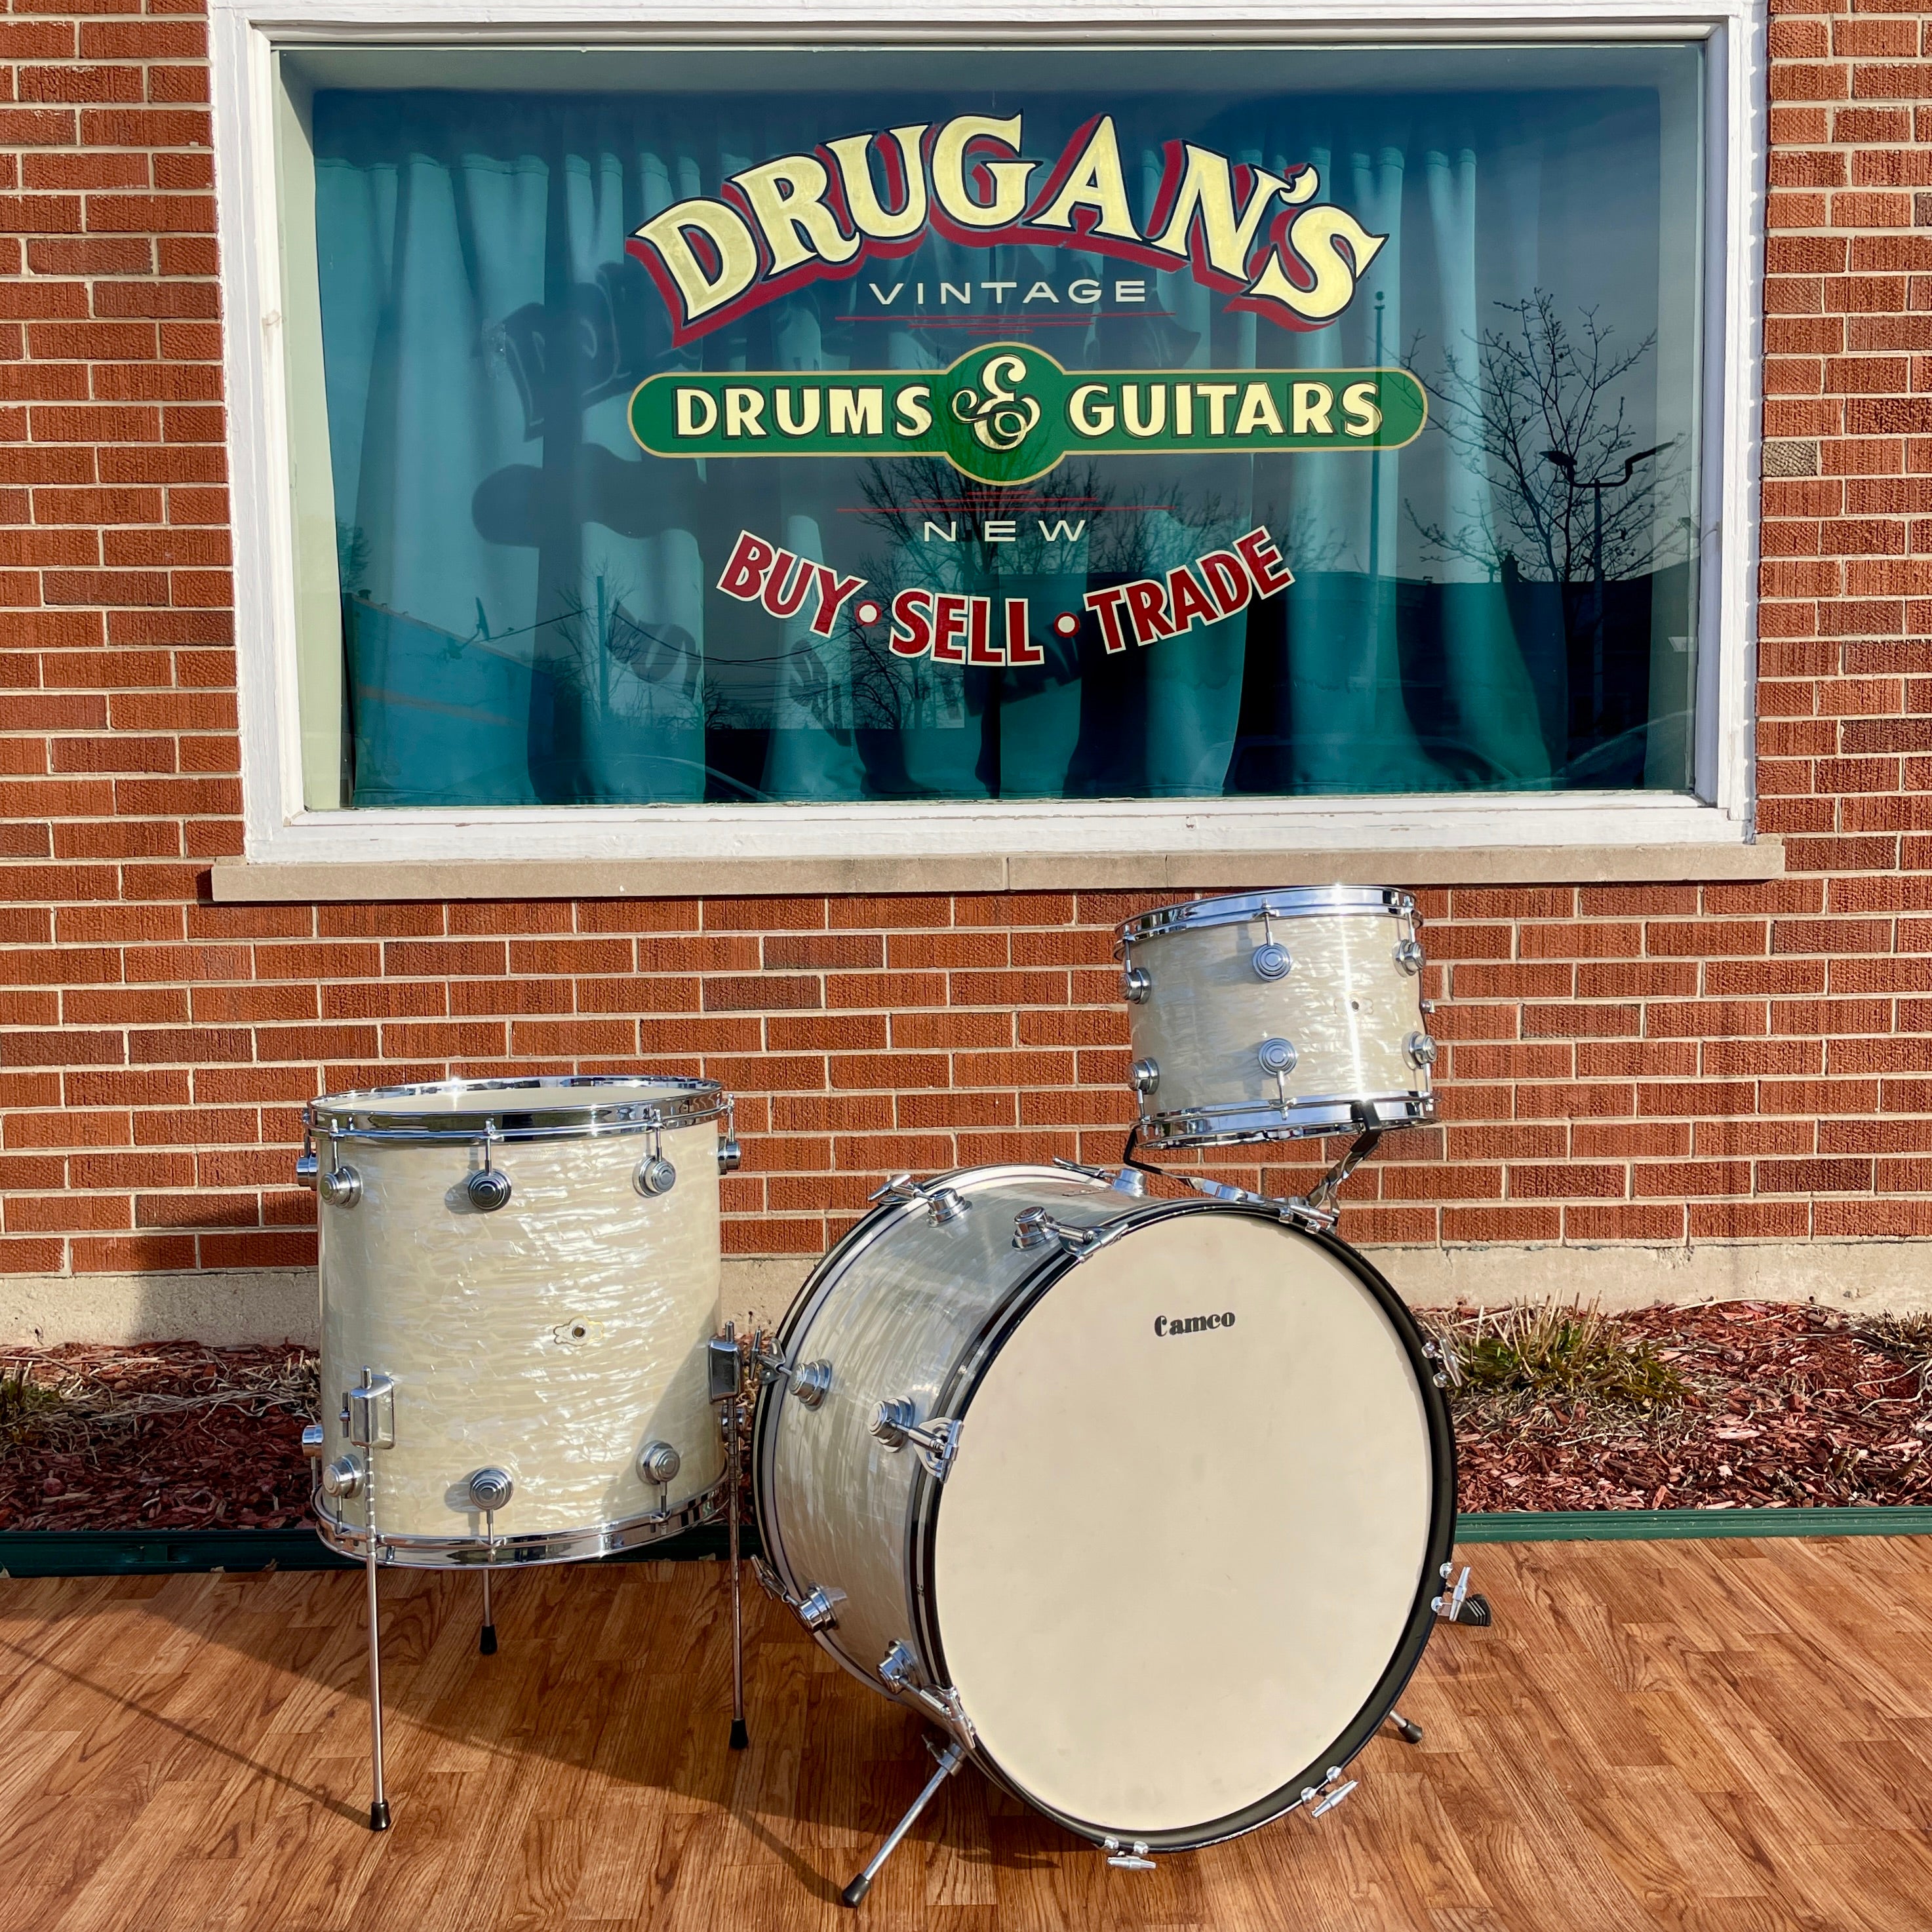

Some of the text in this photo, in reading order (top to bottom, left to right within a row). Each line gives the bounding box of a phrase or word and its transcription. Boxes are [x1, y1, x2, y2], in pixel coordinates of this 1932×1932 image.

[629, 110, 1389, 337] DRUGAN'S
[869, 280, 1146, 305] VINTAGE
[673, 355, 1383, 452] DRUMS & GUITARS
[923, 521, 1086, 542] NEW
[717, 525, 1295, 666] BUY SELL TRADE
[1154, 1312, 1236, 1337] Camco
